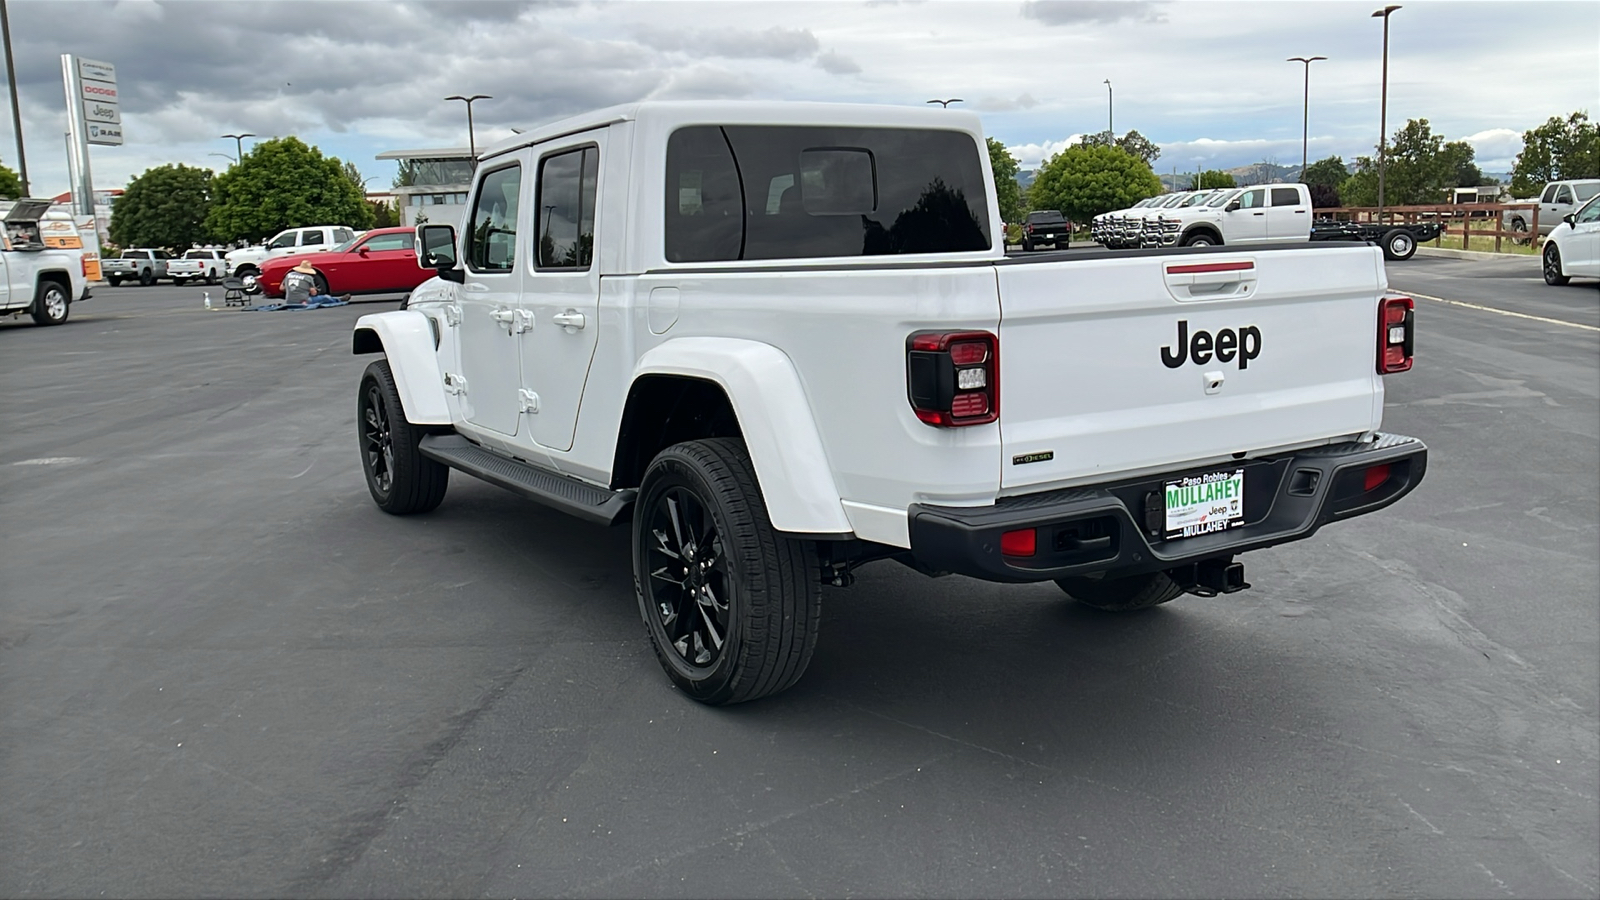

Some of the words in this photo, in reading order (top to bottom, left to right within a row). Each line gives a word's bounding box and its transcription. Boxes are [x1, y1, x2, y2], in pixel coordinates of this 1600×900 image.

[84, 86, 116, 96] DODGE
[93, 104, 114, 119] Jeep
[1160, 320, 1262, 370] Jeep
[1183, 477, 1201, 486] Paso
[1203, 472, 1227, 483] Robles
[1167, 479, 1240, 509] MULLAHEY
[1208, 505, 1227, 515] Jeep
[1183, 519, 1228, 537] MULLAHEY
